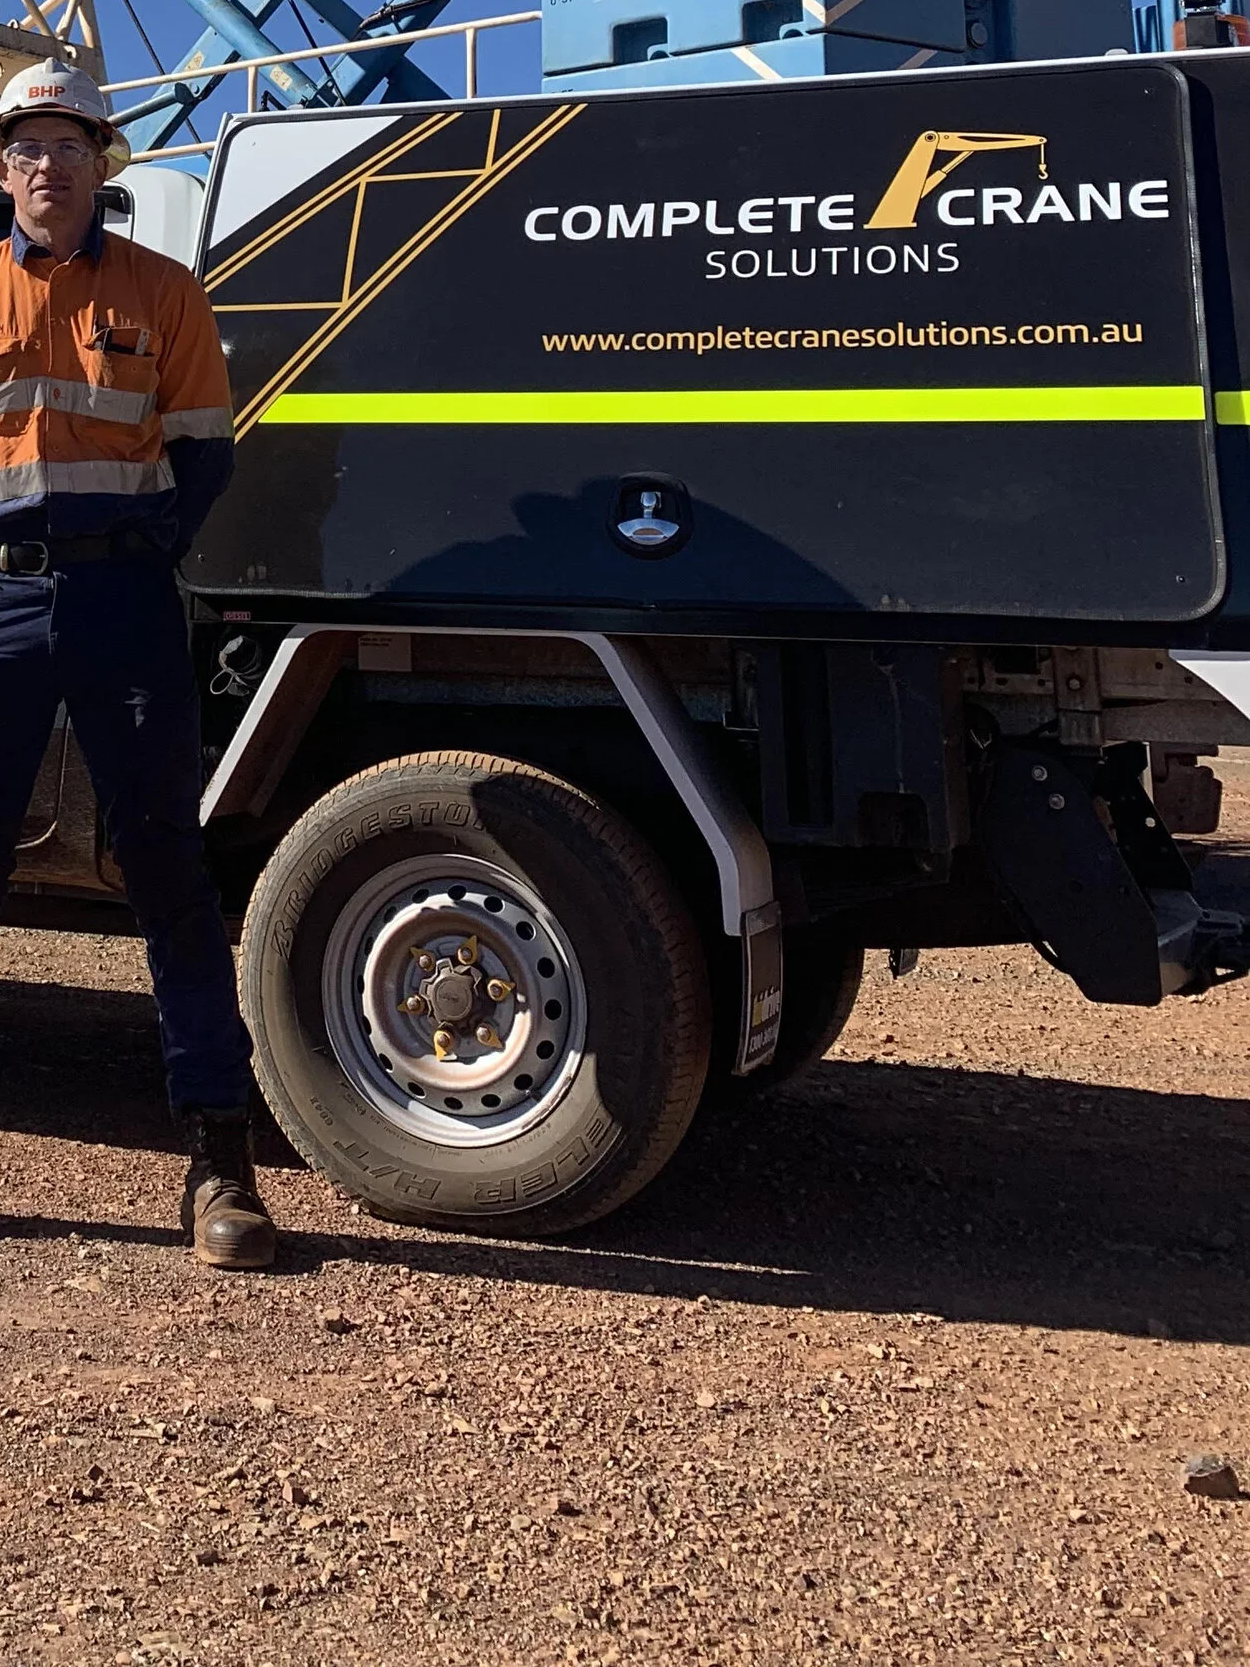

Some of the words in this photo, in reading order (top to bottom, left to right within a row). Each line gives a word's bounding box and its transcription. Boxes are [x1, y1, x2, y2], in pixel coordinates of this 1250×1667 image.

[28, 85, 66, 99] BHP
[524, 194, 855, 242] COMPLETE
[937, 178, 1171, 226] CRANE
[705, 242, 960, 280] SOLUTIONS
[542, 320, 1143, 356] www.completecranesolutions.com.au
[271, 800, 490, 961] BRIDGESTO
